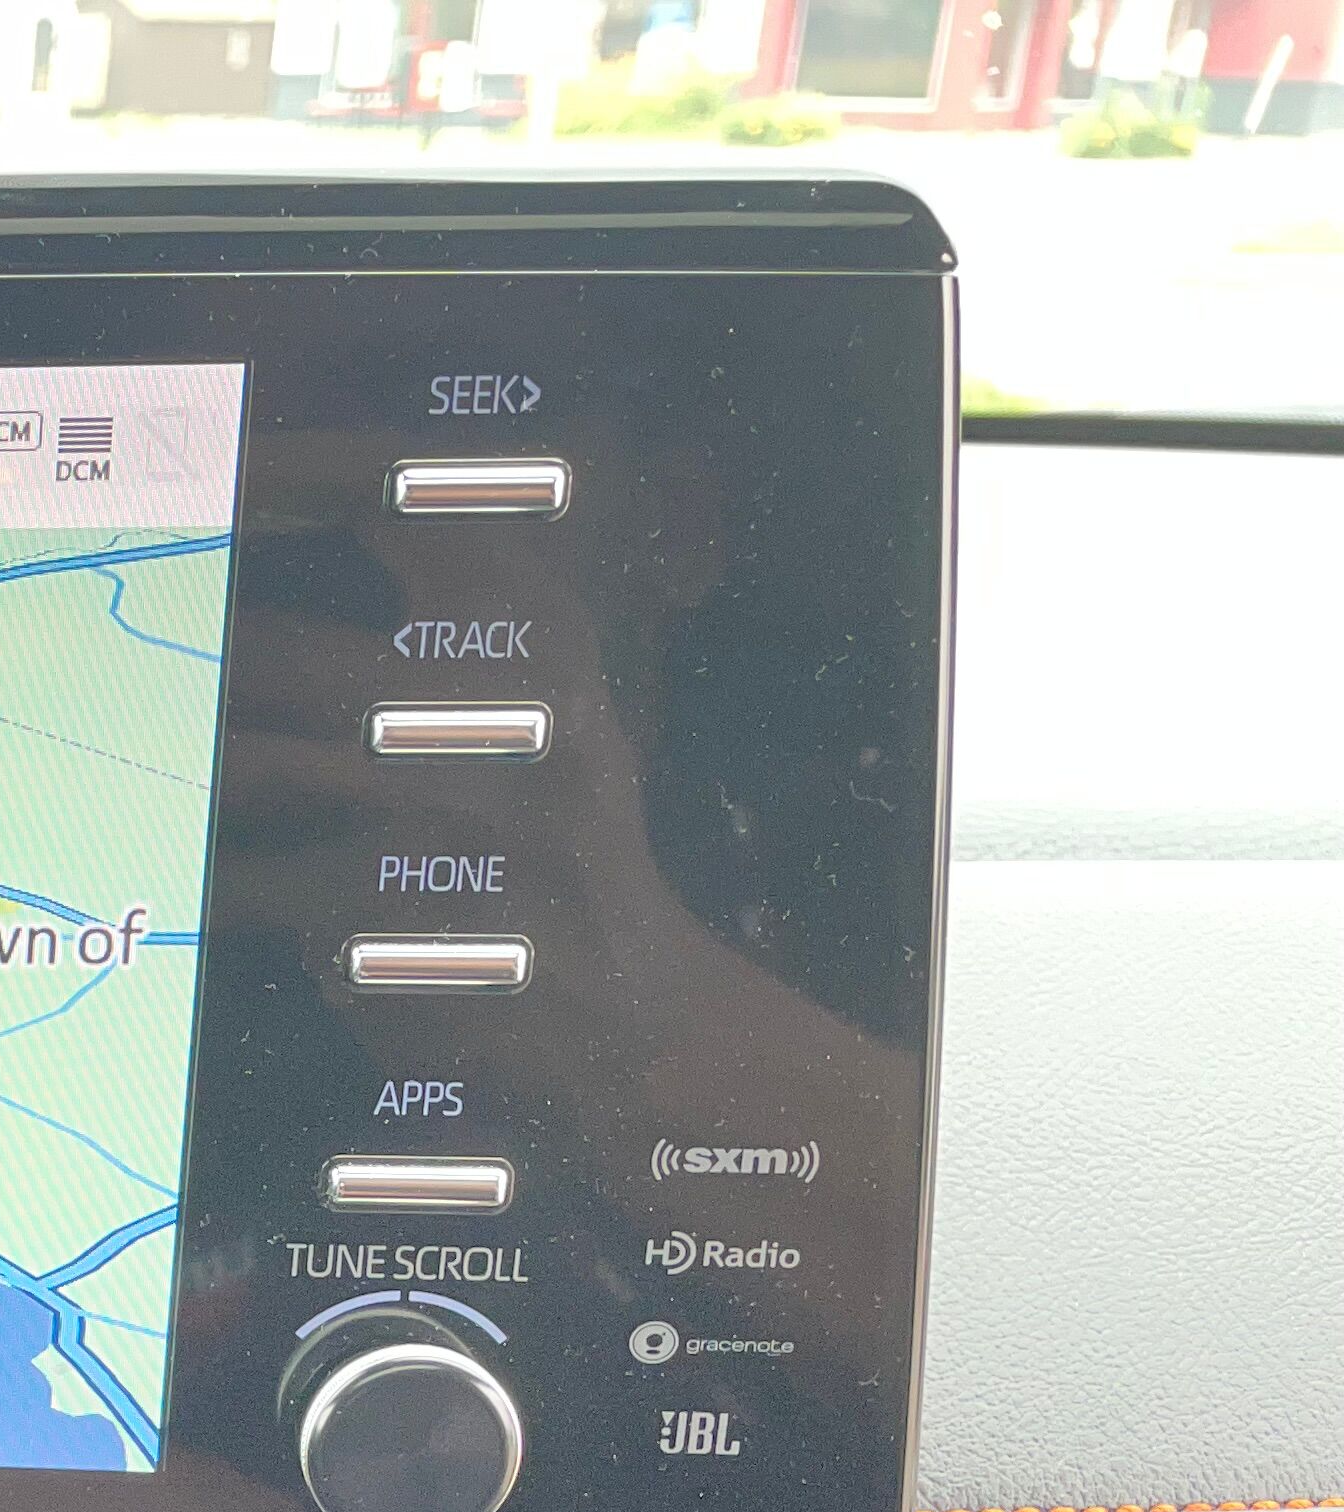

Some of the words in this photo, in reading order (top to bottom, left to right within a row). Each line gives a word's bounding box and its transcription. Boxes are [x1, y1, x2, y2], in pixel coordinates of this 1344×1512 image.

[55, 460, 111, 483] DCM
[378, 855, 505, 892] PHONE
[79, 909, 146, 966] of
[373, 1081, 464, 1117] APPS
[286, 1243, 387, 1279] TUNE
[394, 1246, 528, 1283] SCROLL
[703, 1241, 801, 1269] Radio
[686, 1335, 794, 1356] gracenote
